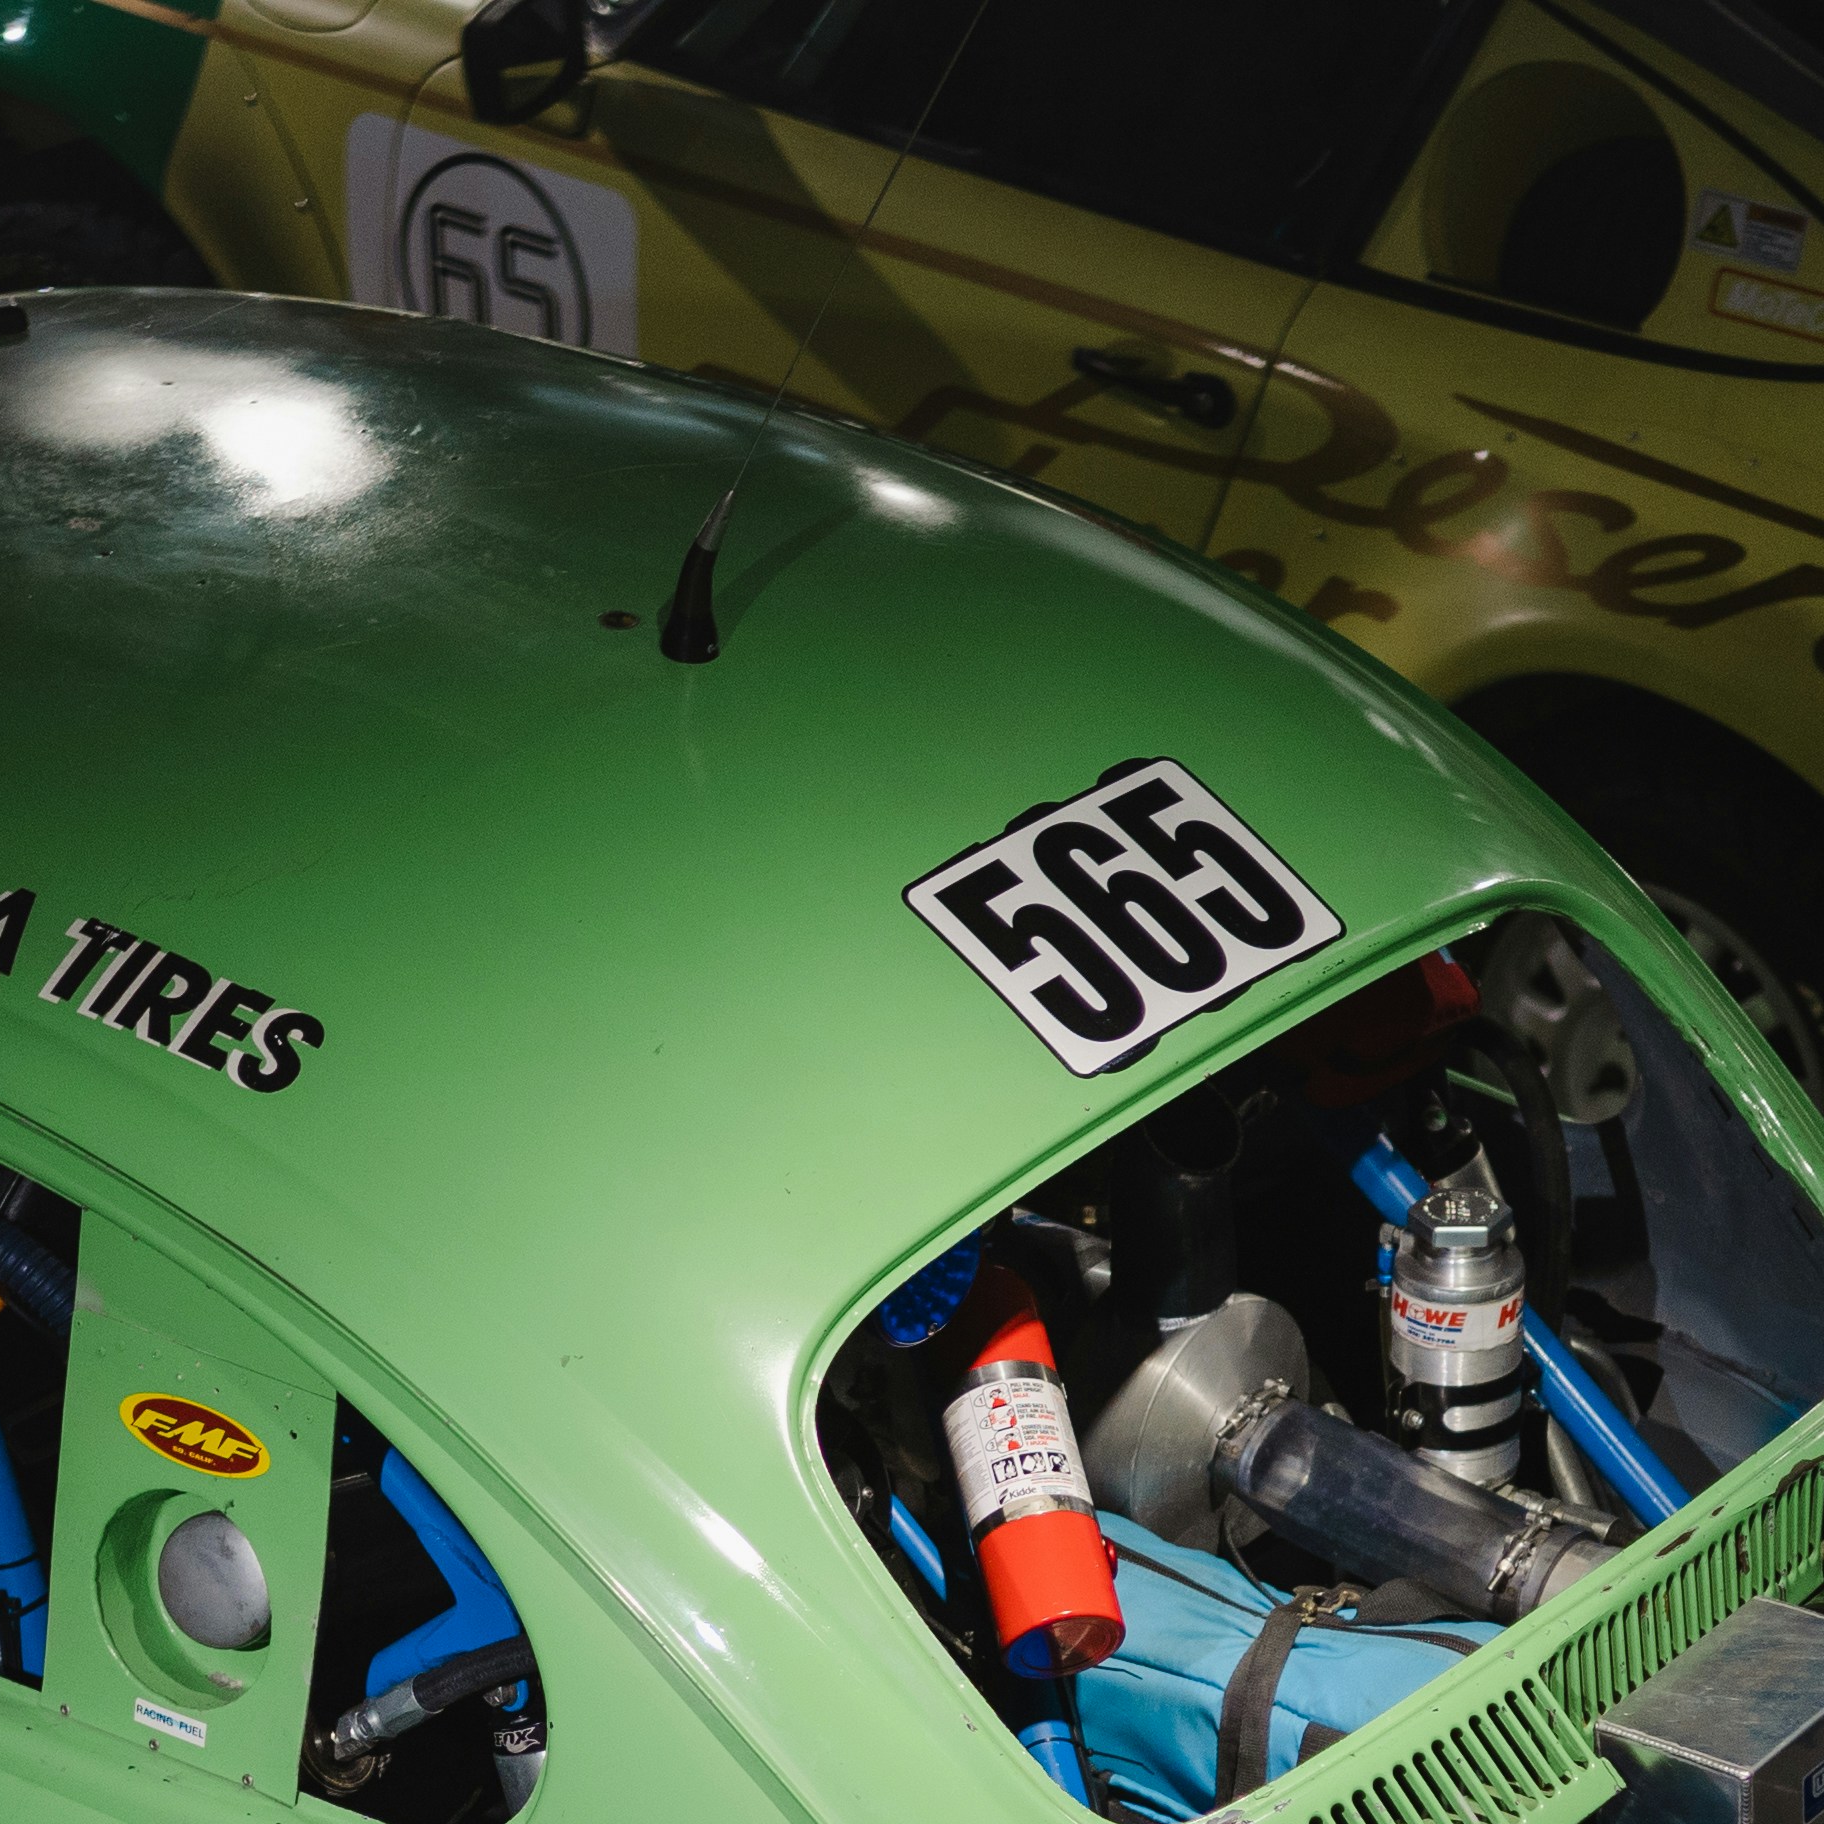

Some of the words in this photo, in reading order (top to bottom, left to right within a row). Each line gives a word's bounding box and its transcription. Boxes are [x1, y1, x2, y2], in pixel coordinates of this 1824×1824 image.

[932, 777, 1306, 1042] 565
[40, 916, 325, 1094] TIRES
[132, 1408, 262, 1459] FMF
[1009, 1487, 1038, 1500] Kidde
[136, 1704, 174, 1727] RACING
[179, 1721, 204, 1739] FUEL
